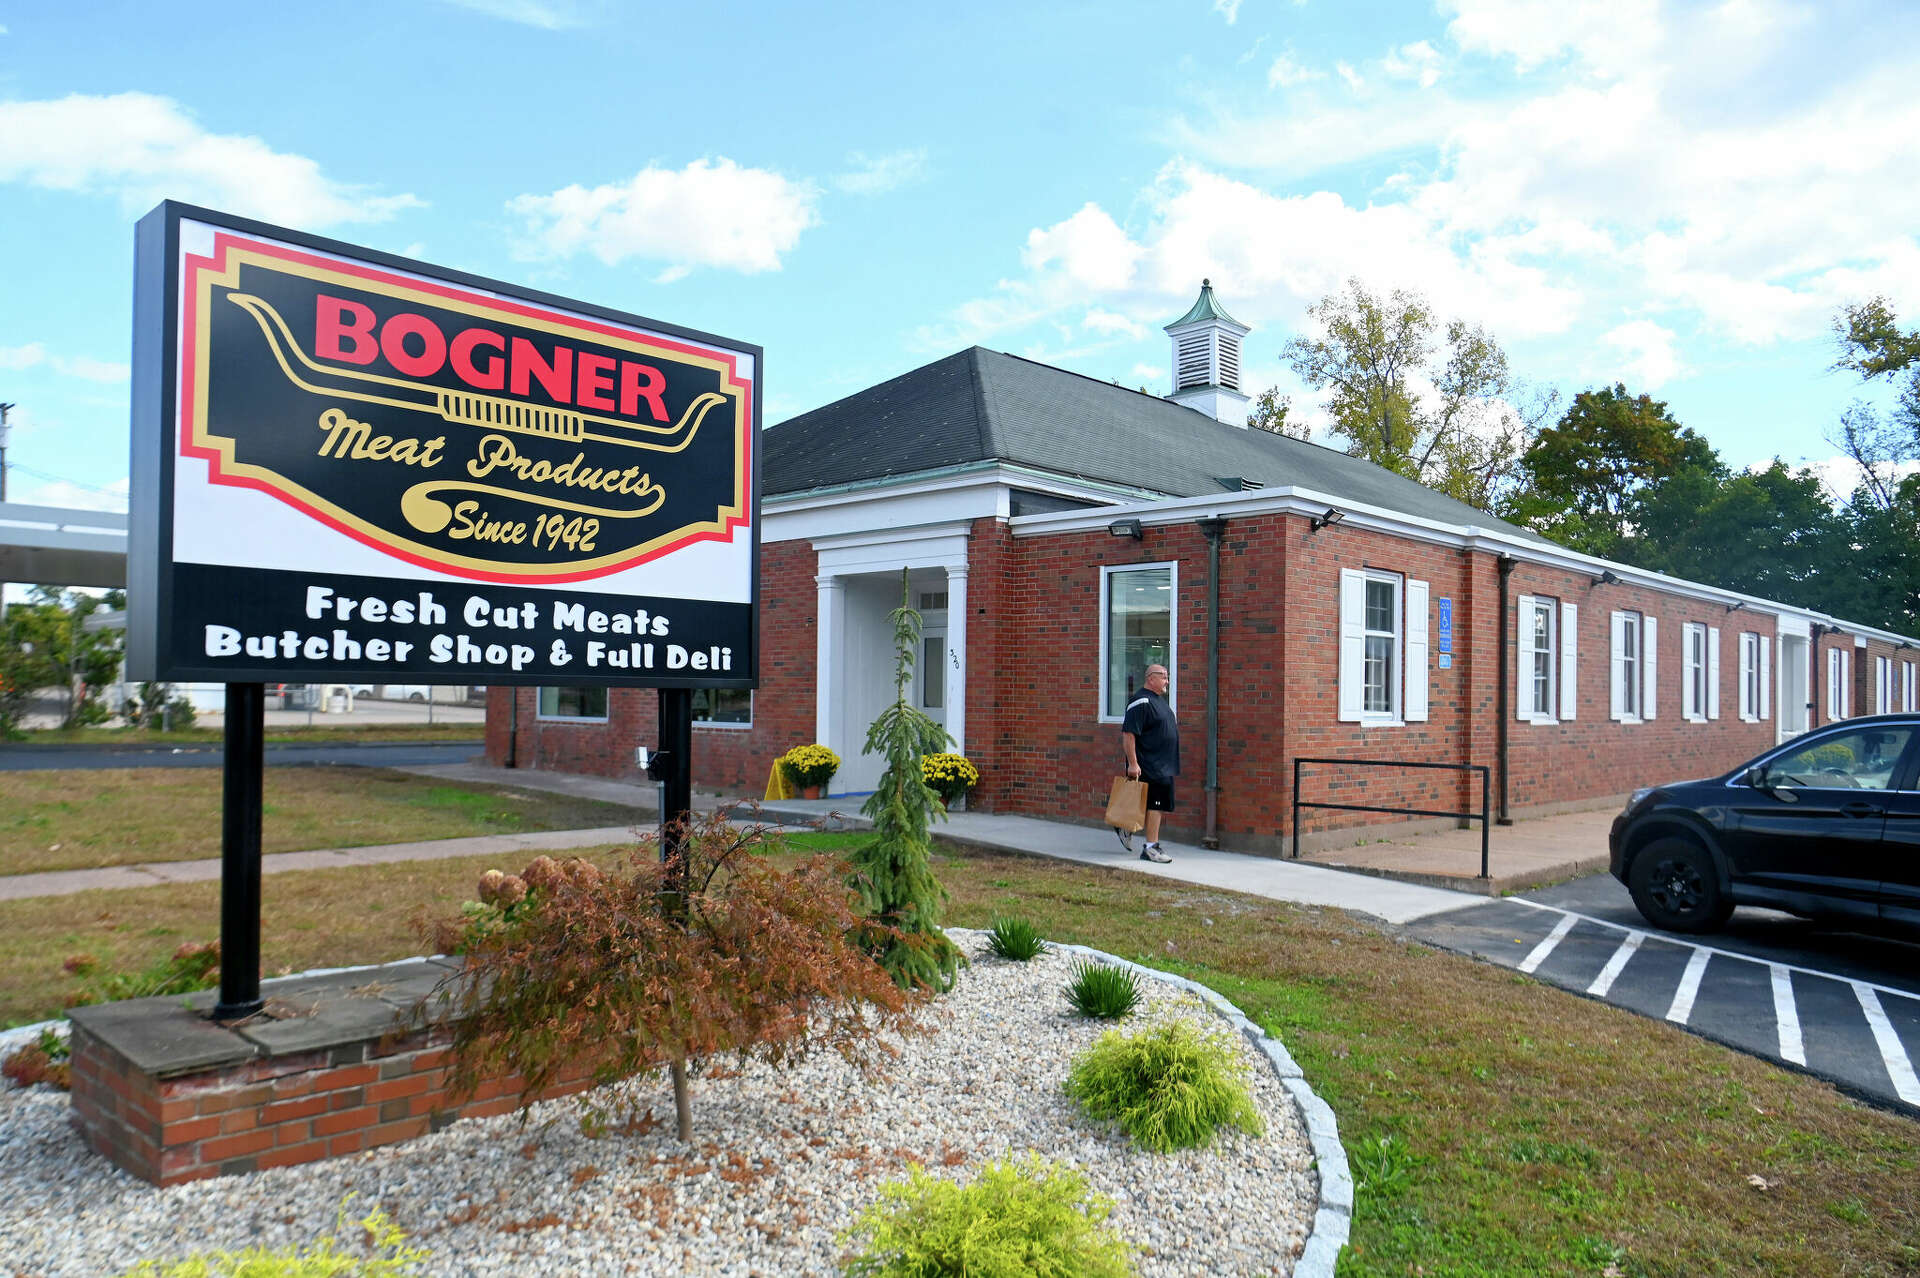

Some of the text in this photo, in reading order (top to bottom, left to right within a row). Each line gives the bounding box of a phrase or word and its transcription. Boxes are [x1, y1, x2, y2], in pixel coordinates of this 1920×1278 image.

[316, 294, 671, 423] BOGNER
[318, 408, 653, 497] Meat Products
[448, 500, 600, 552] Since 1942
[305, 585, 670, 637] Fresh Cut Meats
[204, 624, 732, 672] Butcher Shop & Full Deli
